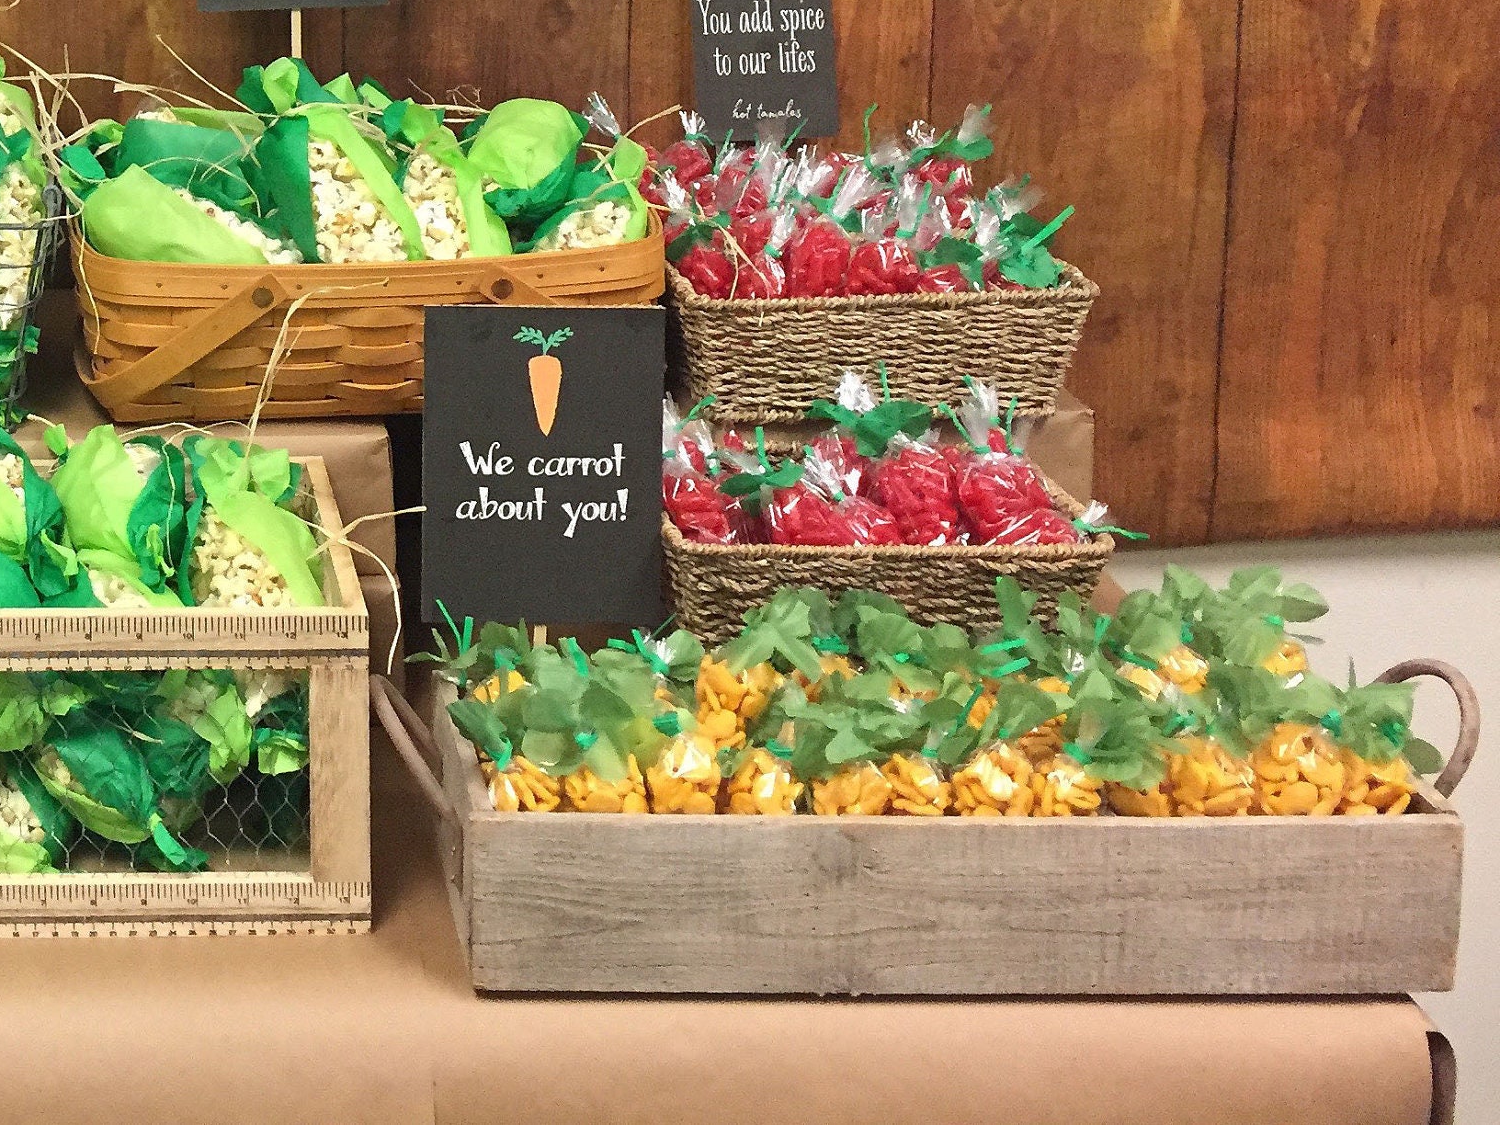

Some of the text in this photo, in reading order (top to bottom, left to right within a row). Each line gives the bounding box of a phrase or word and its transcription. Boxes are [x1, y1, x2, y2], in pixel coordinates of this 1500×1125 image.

[739, 0, 775, 34] add
[779, 0, 825, 44] spice
[712, 37, 816, 76] to our lifes
[458, 440, 626, 477] We carrot
[455, 486, 629, 539] about you!
